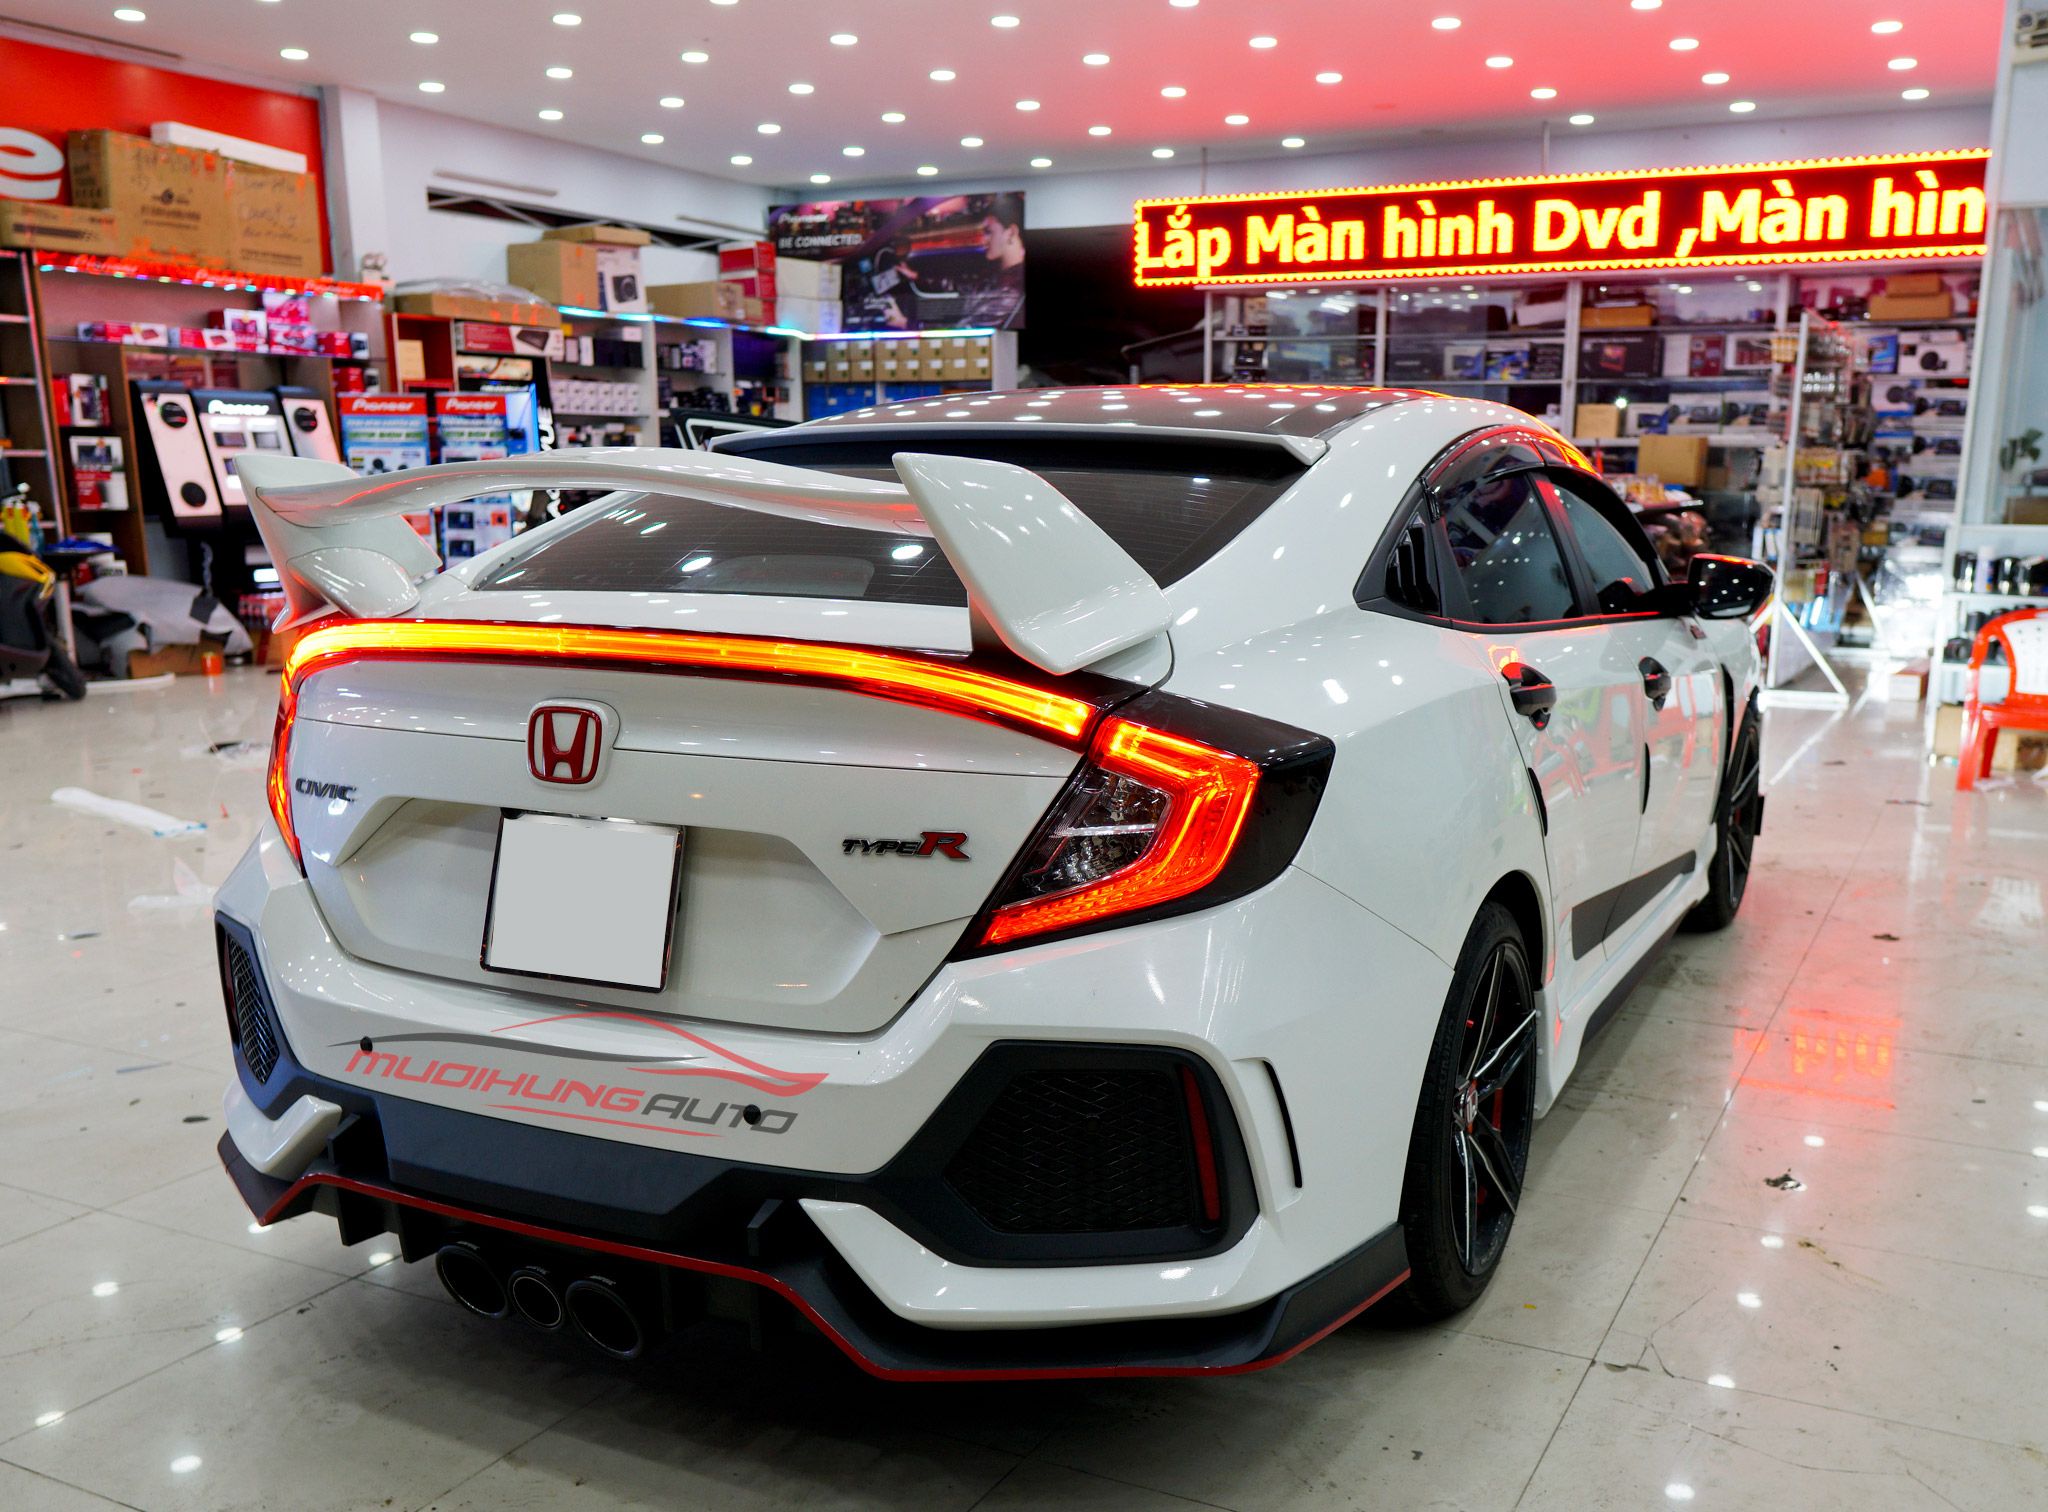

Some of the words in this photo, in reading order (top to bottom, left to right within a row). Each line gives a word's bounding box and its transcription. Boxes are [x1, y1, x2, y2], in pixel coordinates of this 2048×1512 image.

[1140, 204, 1231, 277] Lắp
[1246, 206, 1365, 265] Màn
[1383, 199, 1514, 259] hình
[1533, 190, 1661, 253] Dvd
[352, 398, 414, 412] Pioneer
[445, 398, 497, 411] Pioneer
[295, 777, 357, 802] CIVIC
